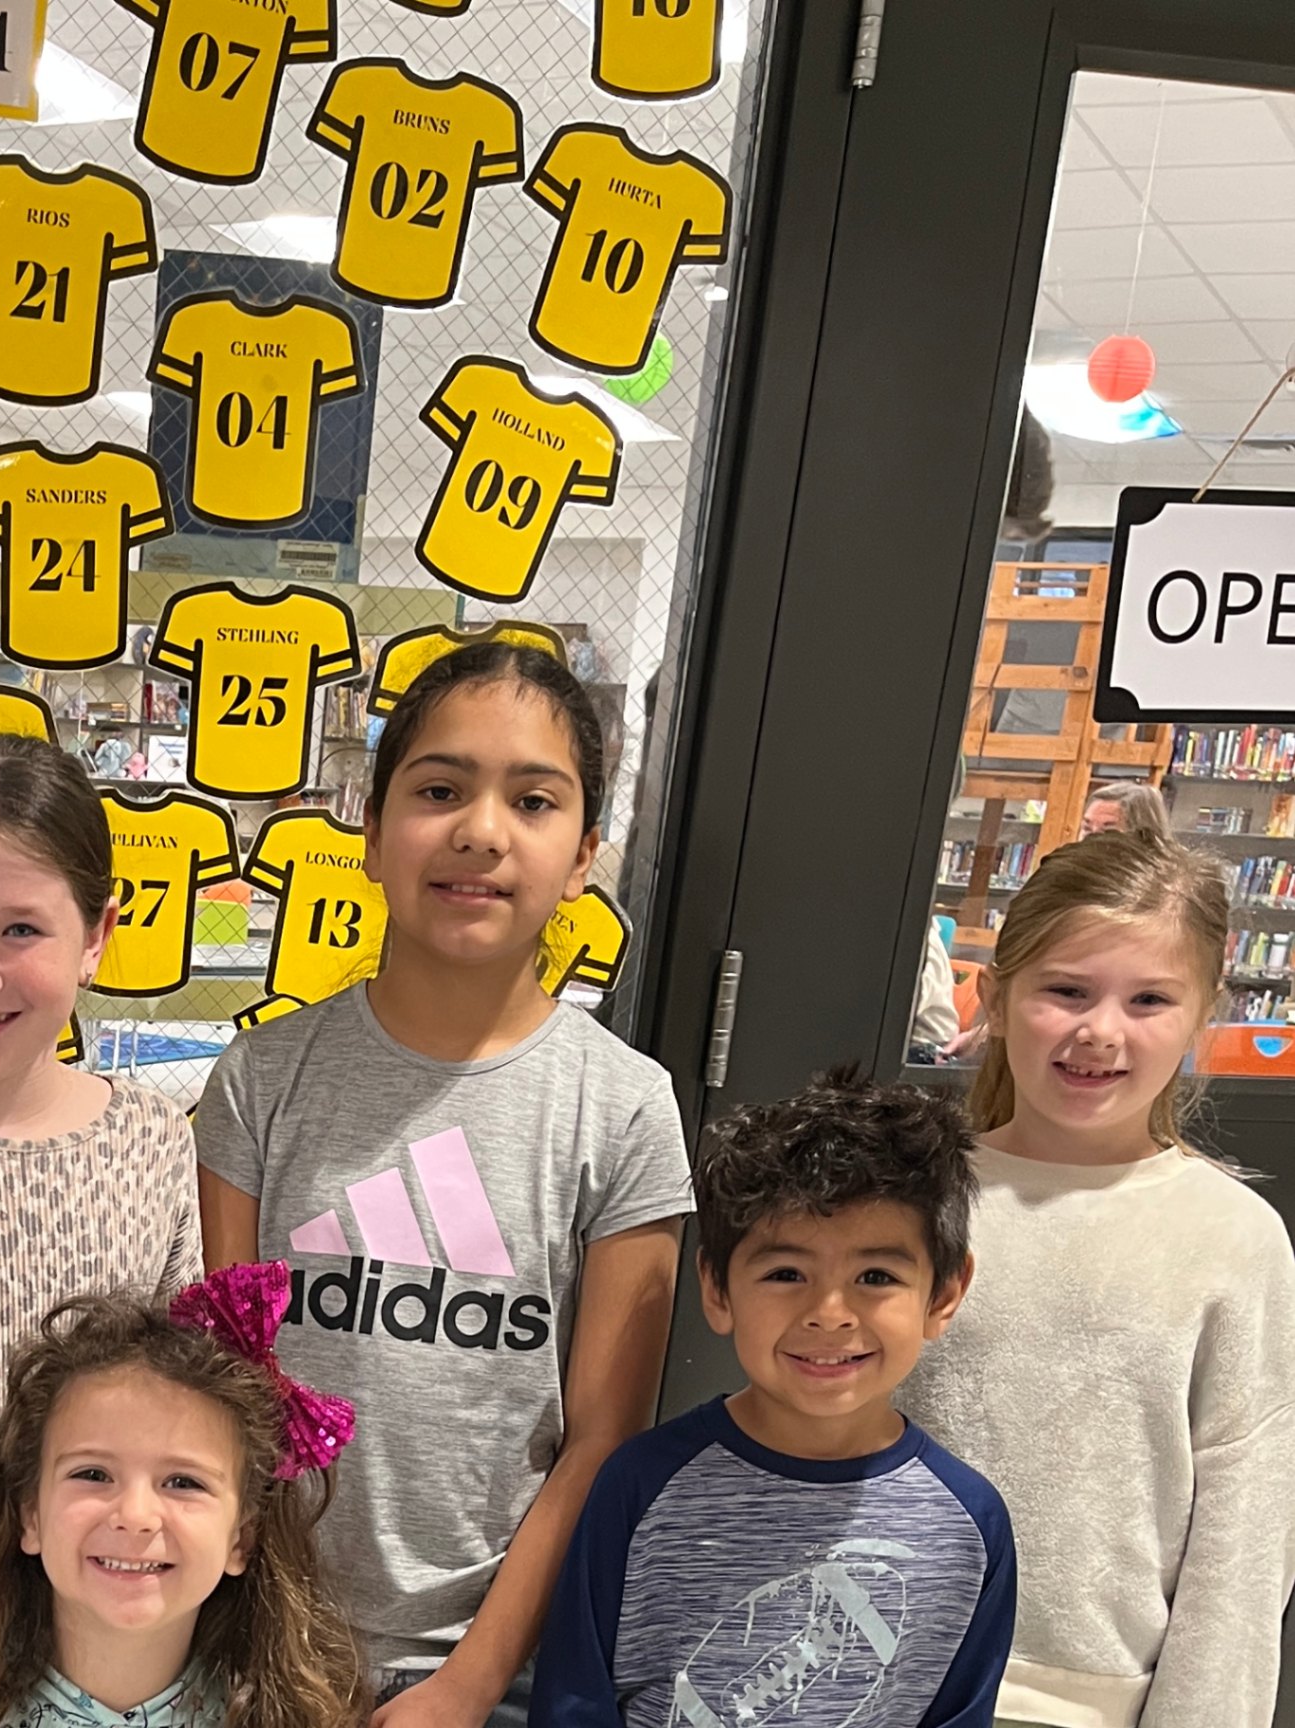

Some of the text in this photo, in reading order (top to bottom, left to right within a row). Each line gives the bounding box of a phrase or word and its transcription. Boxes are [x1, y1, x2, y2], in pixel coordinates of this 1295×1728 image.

[180, 32, 260, 100] 07
[394, 110, 450, 134] BRUNS
[28, 209, 69, 227] RIOS
[370, 162, 448, 228] 02
[609, 178, 660, 209] HURTA
[581, 229, 644, 293] 10
[10, 261, 70, 322] 21
[231, 342, 286, 358] CLARK
[217, 392, 291, 450] 04
[492, 408, 565, 451] HOLLAND
[27, 489, 106, 504] SANDERS
[465, 459, 541, 530] 09
[29, 538, 101, 592] 24
[217, 628, 298, 644] STEHLING
[217, 675, 288, 726] 25
[112, 833, 178, 849] ULLIVAN
[305, 851, 365, 870] LONGO
[112, 877, 171, 928] 27
[309, 898, 361, 948] 13
